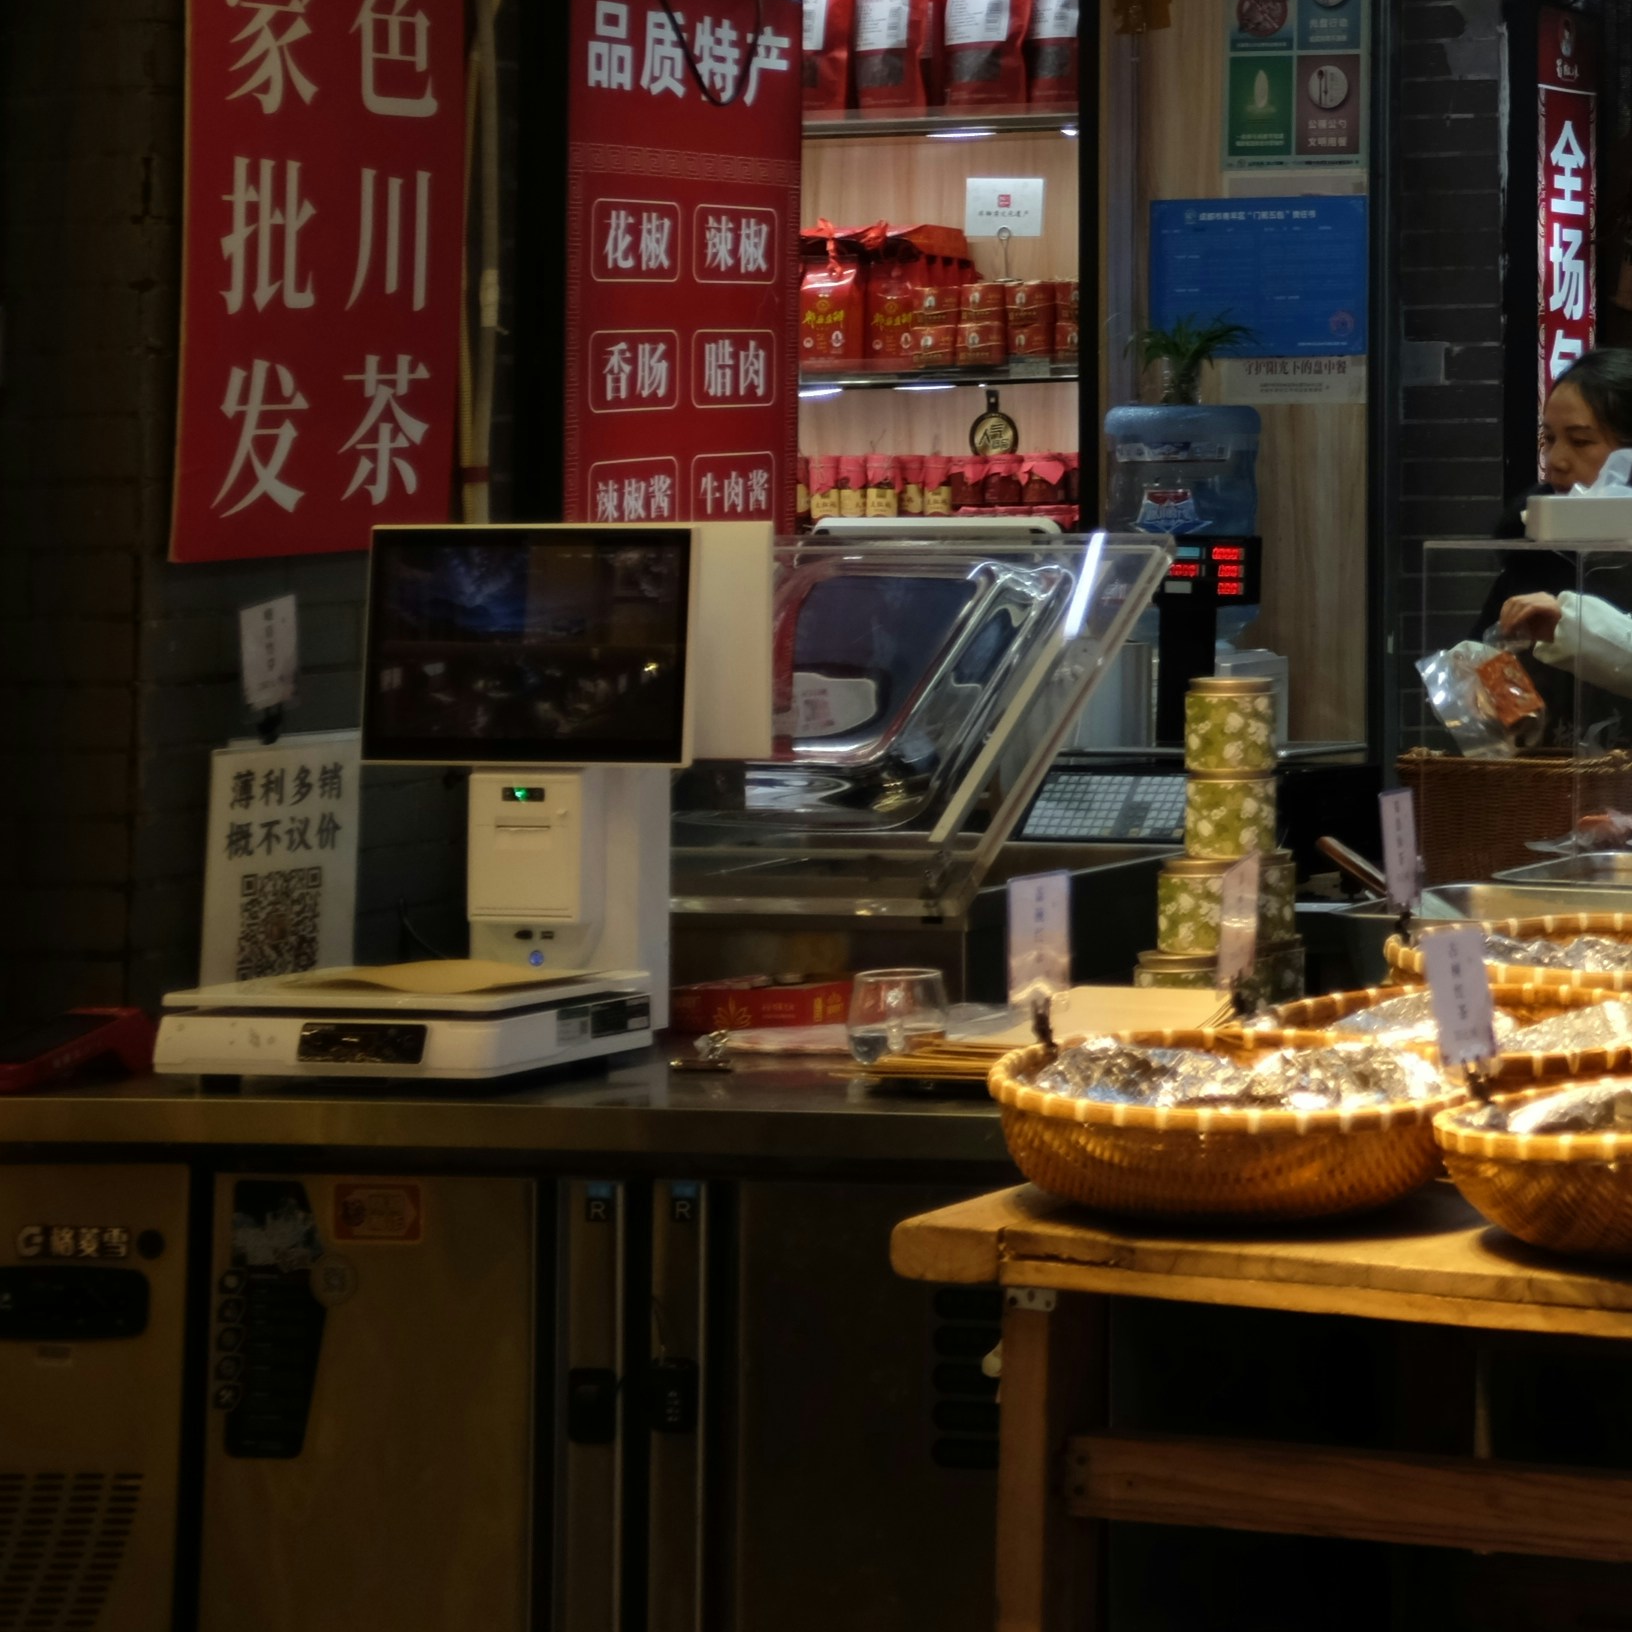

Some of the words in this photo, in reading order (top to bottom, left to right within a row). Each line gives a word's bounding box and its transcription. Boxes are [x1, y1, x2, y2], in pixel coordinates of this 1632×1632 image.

[602, 208, 671, 271] 花椒
[703, 211, 769, 274] 辣椒
[601, 341, 669, 403] 香肠
[702, 339, 766, 398] 腊肉
[595, 474, 673, 522] 辣椒酱
[699, 468, 770, 515] 牛肉酱
[229, 762, 344, 810] 薄利多销
[224, 812, 343, 862] 概不议价
